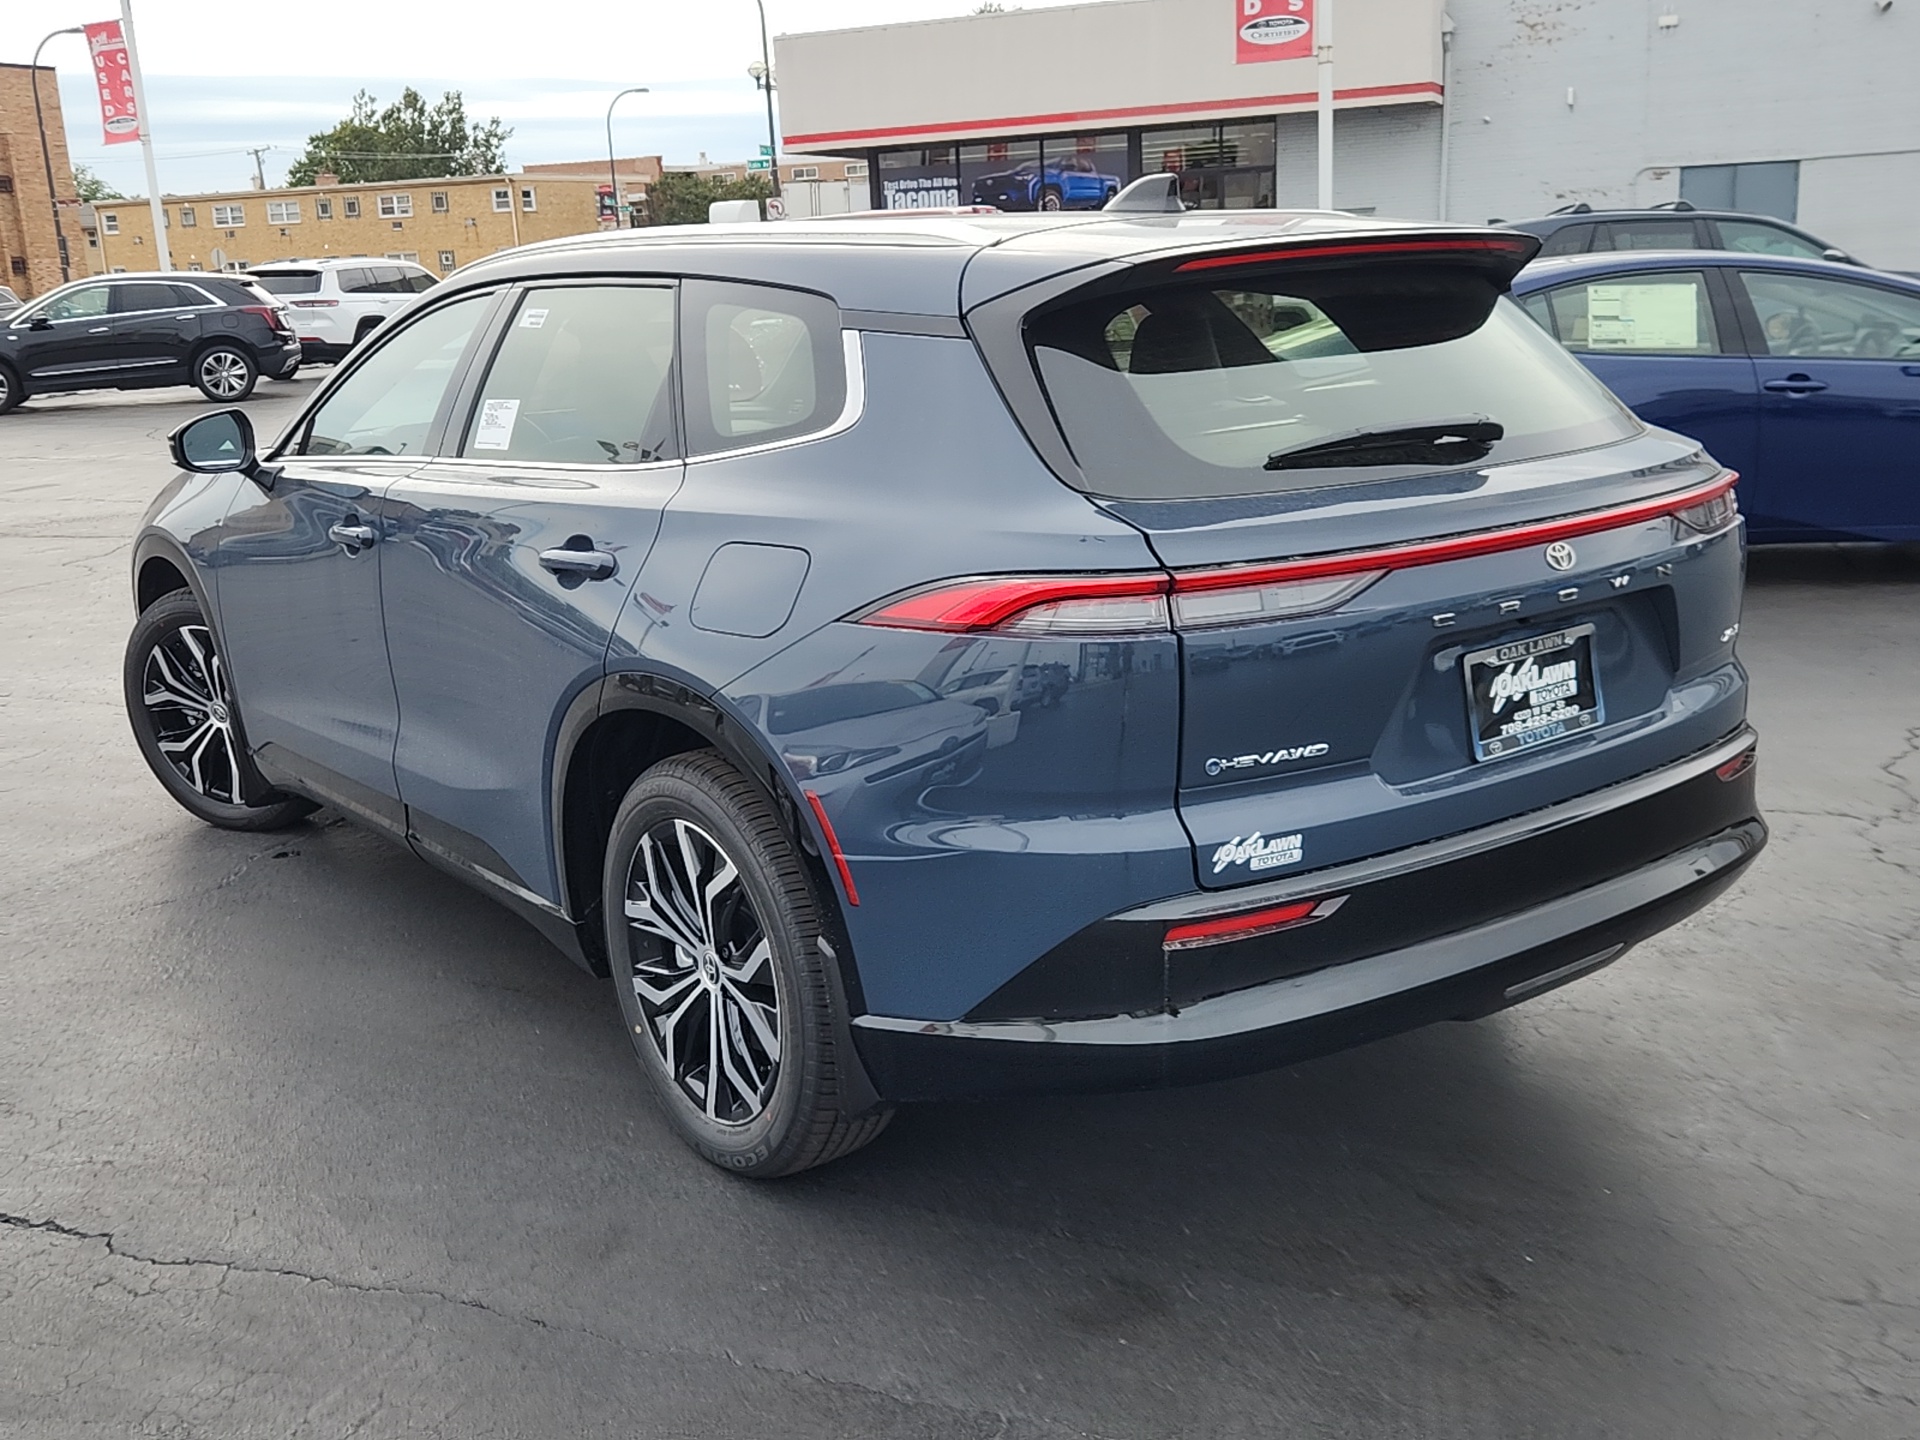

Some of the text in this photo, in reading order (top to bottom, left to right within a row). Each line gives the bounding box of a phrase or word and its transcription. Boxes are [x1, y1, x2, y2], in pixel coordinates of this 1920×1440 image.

[1268, 19, 1294, 28] TOYOTA
[95, 55, 115, 117] USED
[116, 52, 136, 115] CARS
[883, 180, 899, 191] Test
[900, 179, 918, 189] Drive
[918, 178, 931, 188] The
[932, 177, 942, 187] All
[883, 189, 959, 210] Tacoma
[1432, 562, 1674, 628] CROWN
[1500, 634, 1563, 660] OAK LAWN
[1535, 682, 1572, 701] TOYOTA
[1516, 722, 1566, 745] TOYOTA
[1257, 851, 1294, 866] TOYOTA
